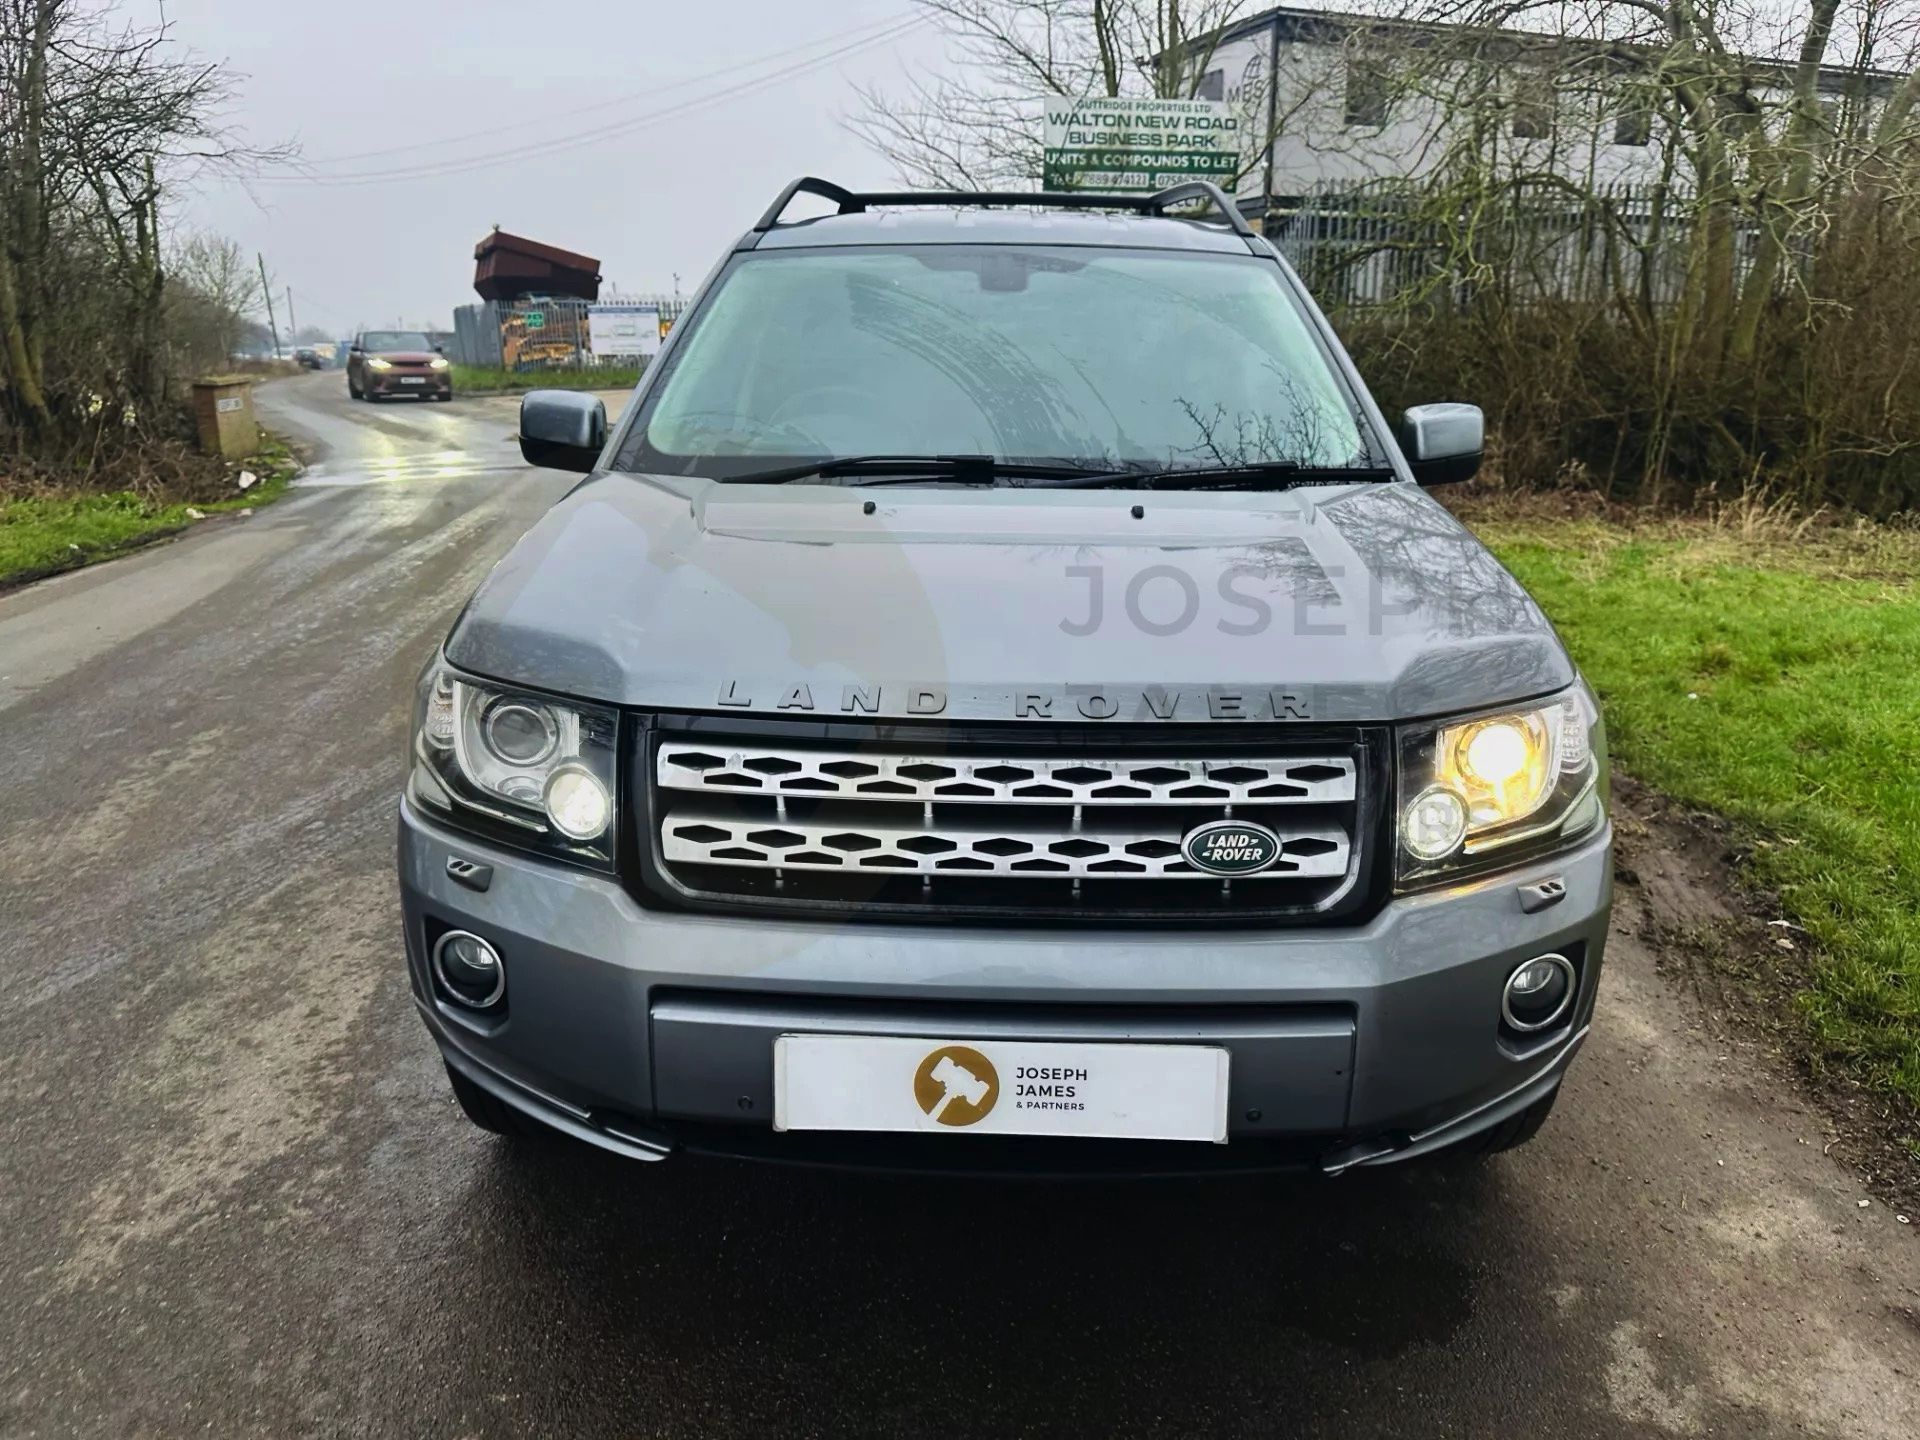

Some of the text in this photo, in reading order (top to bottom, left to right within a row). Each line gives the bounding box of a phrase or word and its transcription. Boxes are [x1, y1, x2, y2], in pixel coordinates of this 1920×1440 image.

[1136, 102, 1191, 112] PROPERTIES
[1195, 103, 1212, 113] LTD
[1048, 112, 1238, 130] WALTON NEW ROAD
[1069, 131, 1217, 147] BUSINESS PARK
[1045, 153, 1087, 165] UNITS
[1103, 154, 1189, 167] COMPOUNDS
[1193, 156, 1210, 167] TO
[1214, 157, 1237, 168] LET
[717, 679, 1311, 719] LAND ROVER
[1207, 834, 1250, 848] LAND
[1211, 848, 1263, 861] ROVER
[1016, 1067, 1087, 1081] JOSEPH
[1016, 1084, 1076, 1097] JAMES
[1016, 1101, 1085, 1111] & PARTNERS
